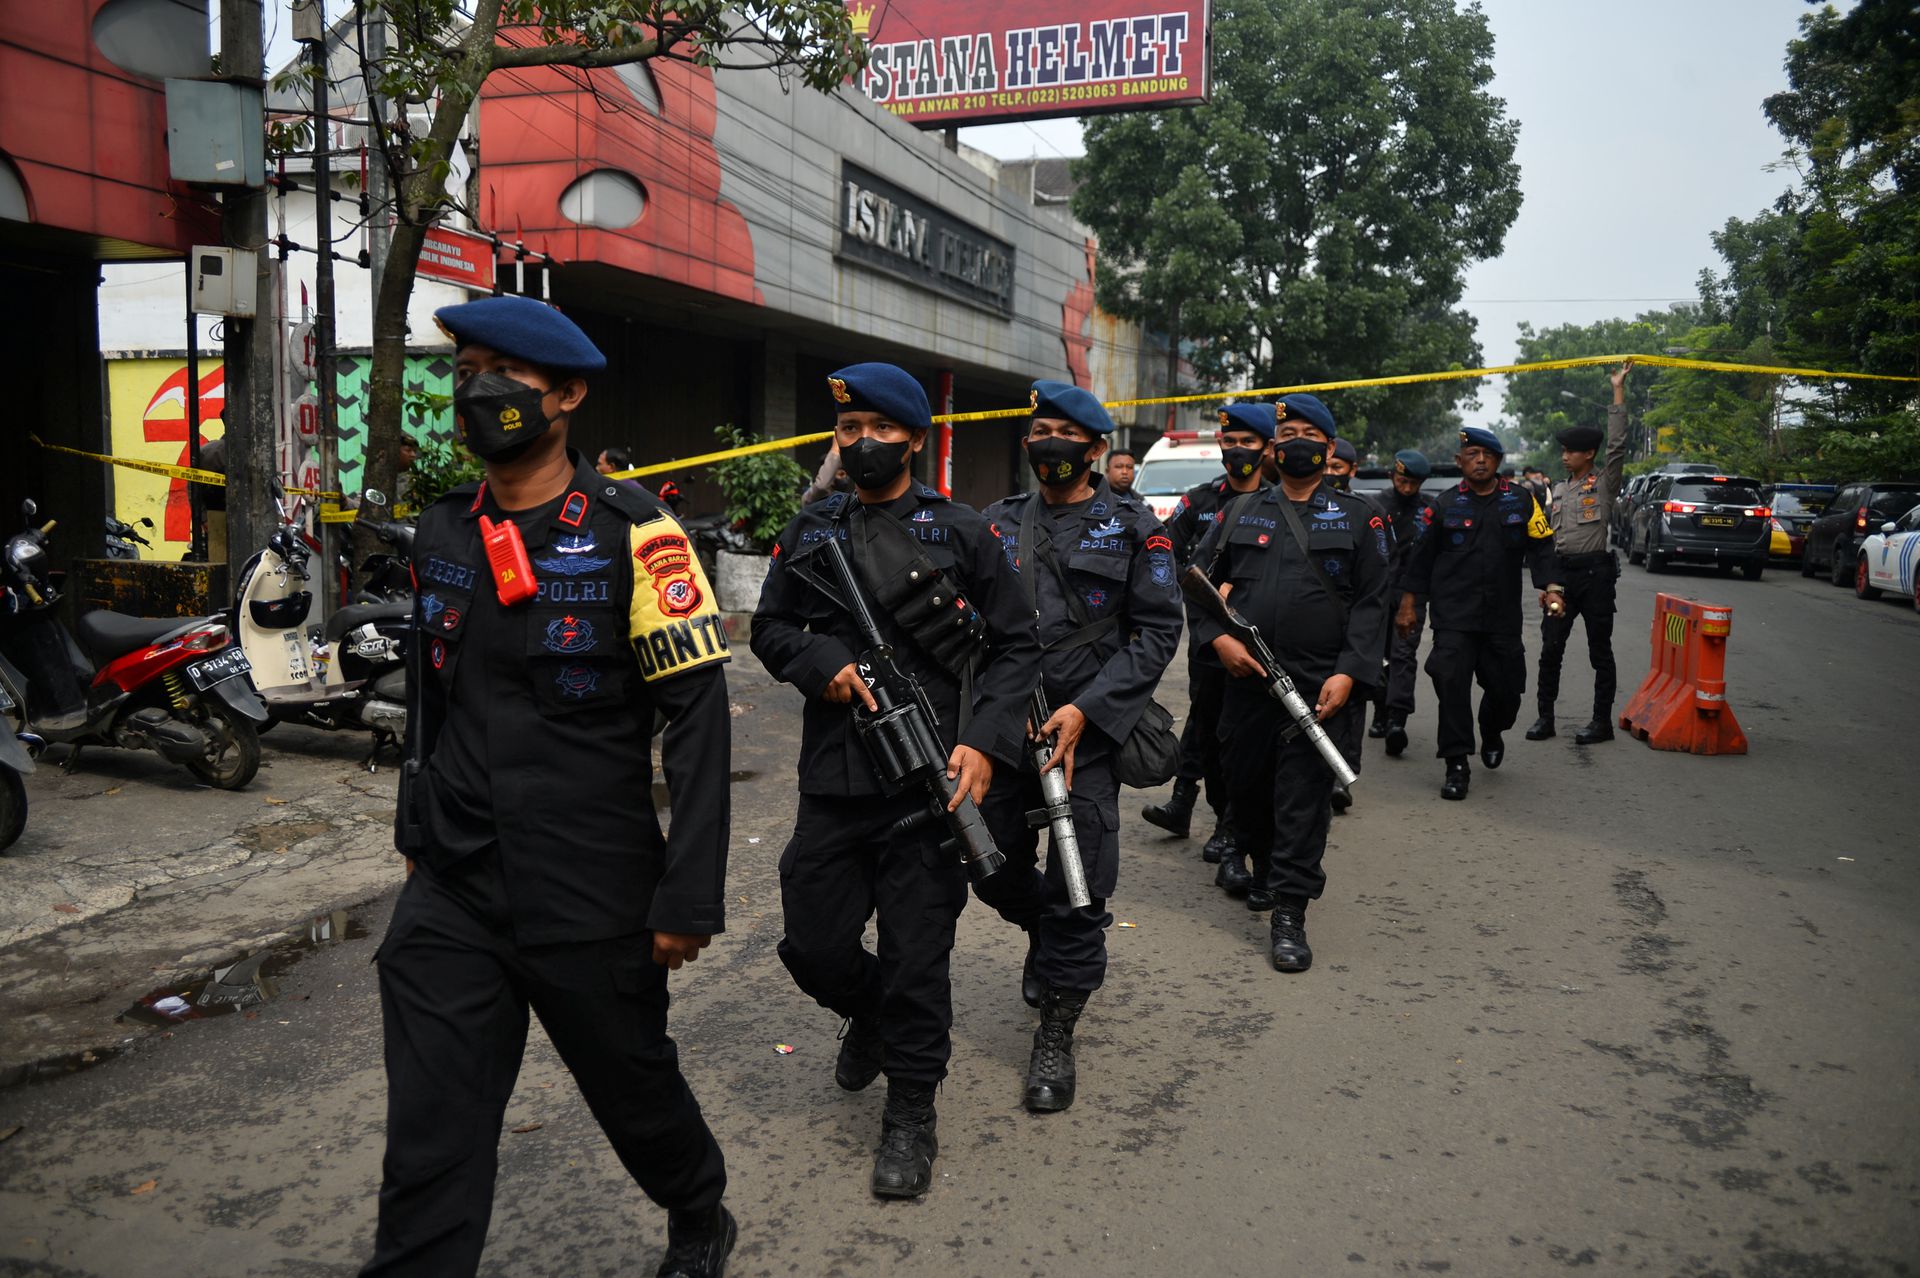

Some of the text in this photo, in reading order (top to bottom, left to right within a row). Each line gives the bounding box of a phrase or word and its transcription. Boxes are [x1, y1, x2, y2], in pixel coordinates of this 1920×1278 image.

[853, 11, 1189, 103] ISTANA HELMET
[918, 98, 959, 113] ANYAR
[963, 95, 986, 110] 210
[991, 91, 1024, 108] TELP.
[1027, 88, 1060, 106] (022)
[1062, 83, 1117, 101] 5203063
[1121, 77, 1189, 96] BANDUNG
[846, 181, 931, 267] ISTANA
[440, 254, 476, 273] INDONESIA
[503, 421, 523, 431] POLRI
[1311, 521, 1350, 531] POLRI
[1080, 538, 1125, 552] POLRI
[649, 554, 689, 571] JAWA BARAT
[501, 568, 516, 584] 2A
[533, 581, 609, 602] POLRI
[634, 614, 727, 678] DANTO
[191, 667, 201, 678] D
[203, 656, 229, 672] 5734
